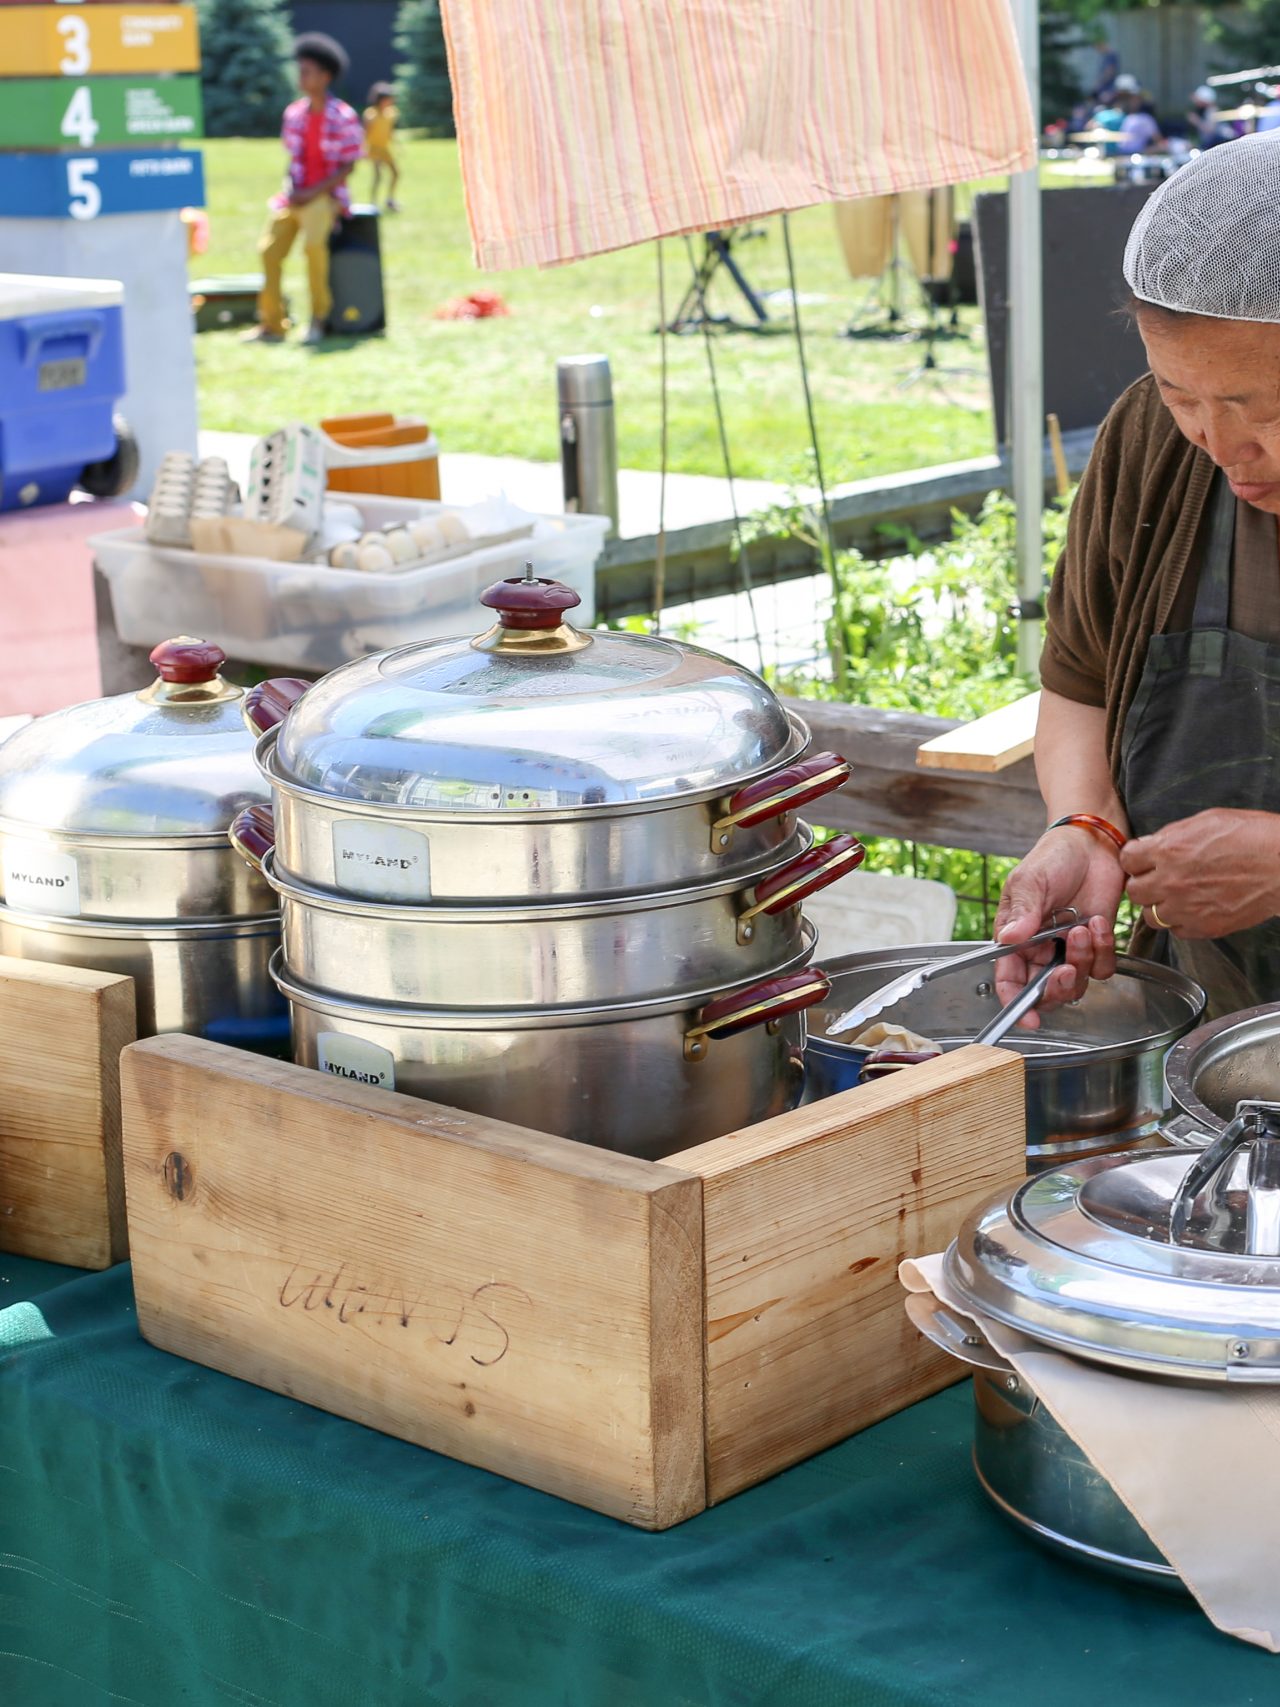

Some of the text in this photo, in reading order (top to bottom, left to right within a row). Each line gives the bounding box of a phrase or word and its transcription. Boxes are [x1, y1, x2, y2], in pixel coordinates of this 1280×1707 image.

[57, 14, 91, 76] 3
[61, 86, 99, 148] 4
[66, 157, 102, 220] 5
